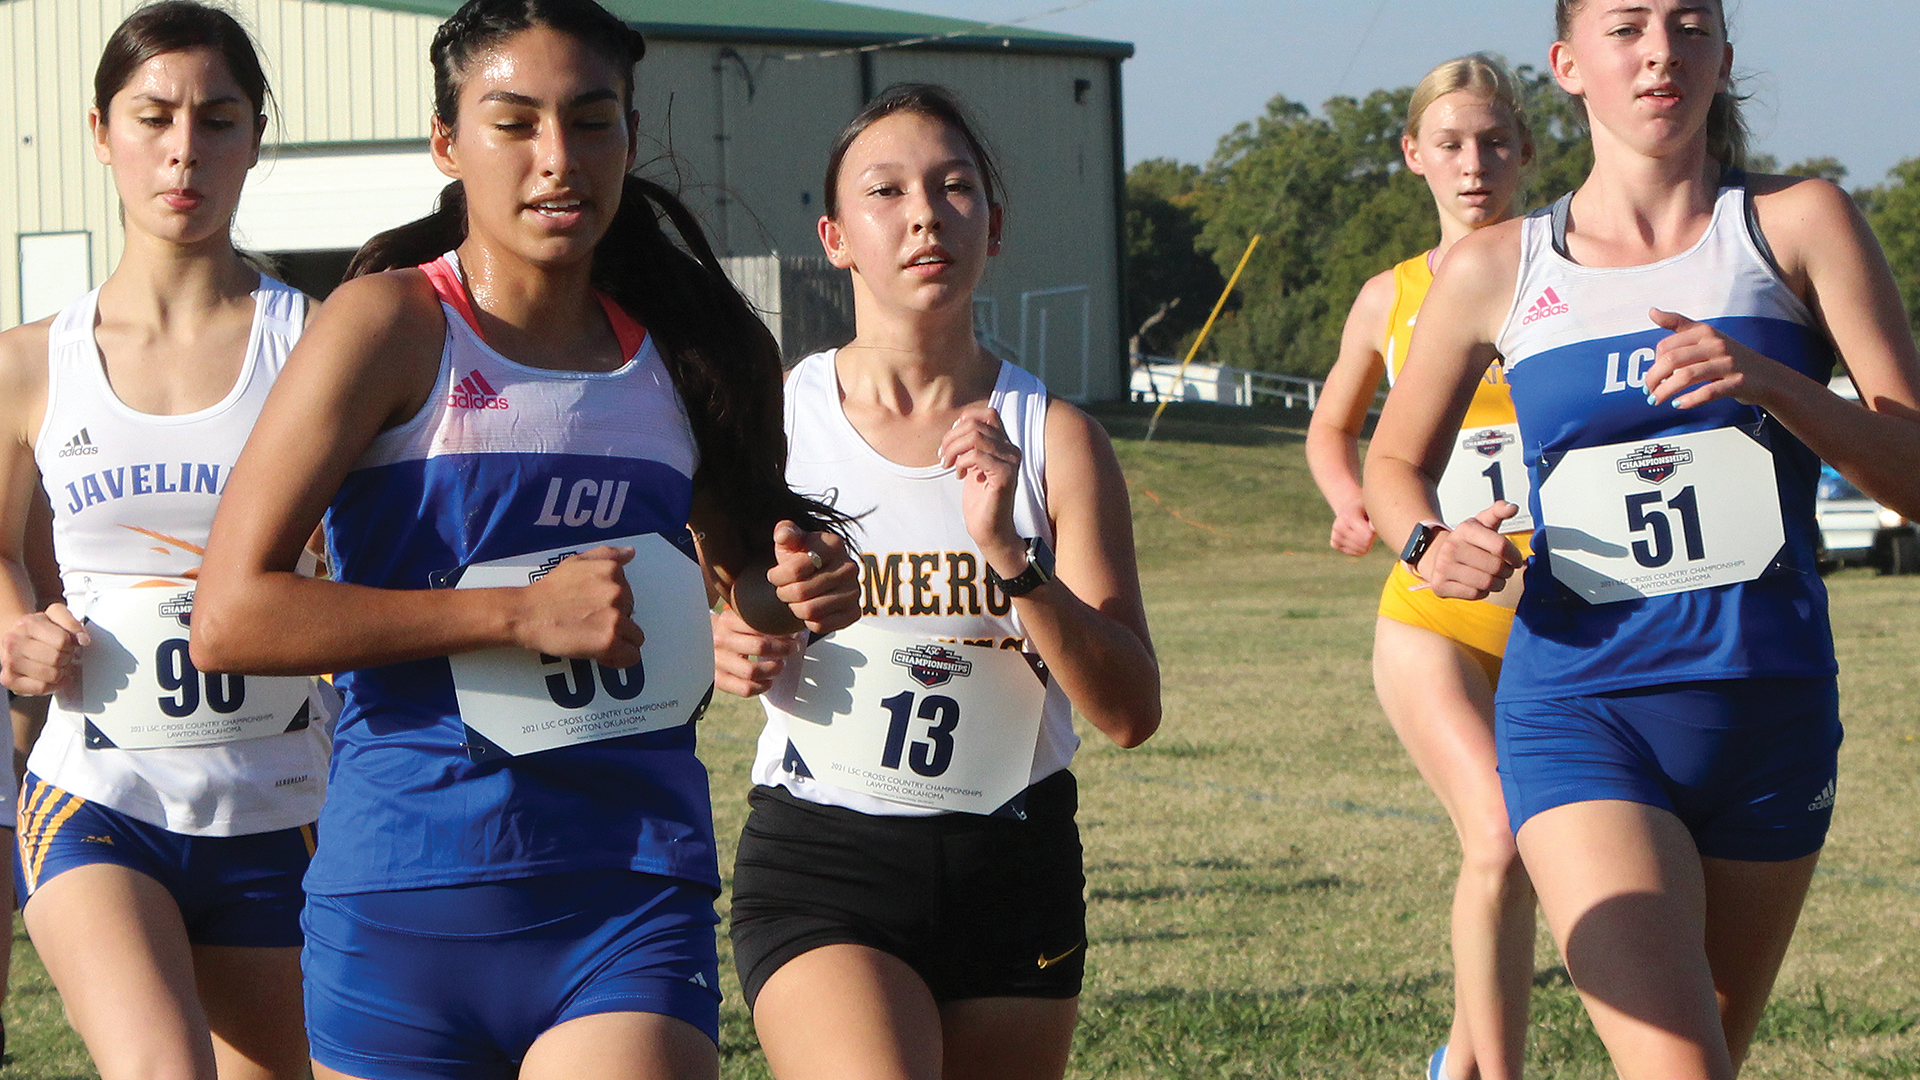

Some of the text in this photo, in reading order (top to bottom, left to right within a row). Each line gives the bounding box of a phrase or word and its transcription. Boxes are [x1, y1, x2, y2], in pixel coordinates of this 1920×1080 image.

[1522, 303, 1569, 325] adidas
[1601, 347, 1655, 394] LC
[446, 394, 509, 410] adidas
[58, 445, 99, 458] adidas
[1621, 453, 1689, 470] CHAMPIONSHIPS
[1482, 460, 1506, 502] 1
[533, 477, 631, 529] LCU
[1624, 484, 1706, 568] 51
[1630, 574, 1653, 584] CROSS
[1654, 569, 1688, 581] COUNTRY
[1690, 560, 1746, 575] CHAMPIONSHIPS
[1670, 573, 1712, 586] OKLAHOMA
[925, 646, 941, 655] LSC
[896, 653, 968, 672] CHAMPIONSHIPS
[161, 722, 184, 731] CROSS
[185, 719, 220, 730] COUNTRY
[221, 713, 274, 727] CHAMPIONSHIPS
[522, 700, 679, 734] 2021 LSC CROSS COUNTRY CHAMPIONSHIPS
[603, 715, 646, 729] OKLAHOMA
[201, 726, 242, 736] OKLAHOMA
[880, 690, 960, 777] 13
[831, 762, 846, 772] 2021
[847, 767, 861, 776] LSC
[862, 771, 886, 781] CROSS
[887, 776, 924, 788] COUNTRY
[925, 783, 983, 797] CHAMPIONSHIPS
[902, 788, 945, 800] OKLAHOMA
